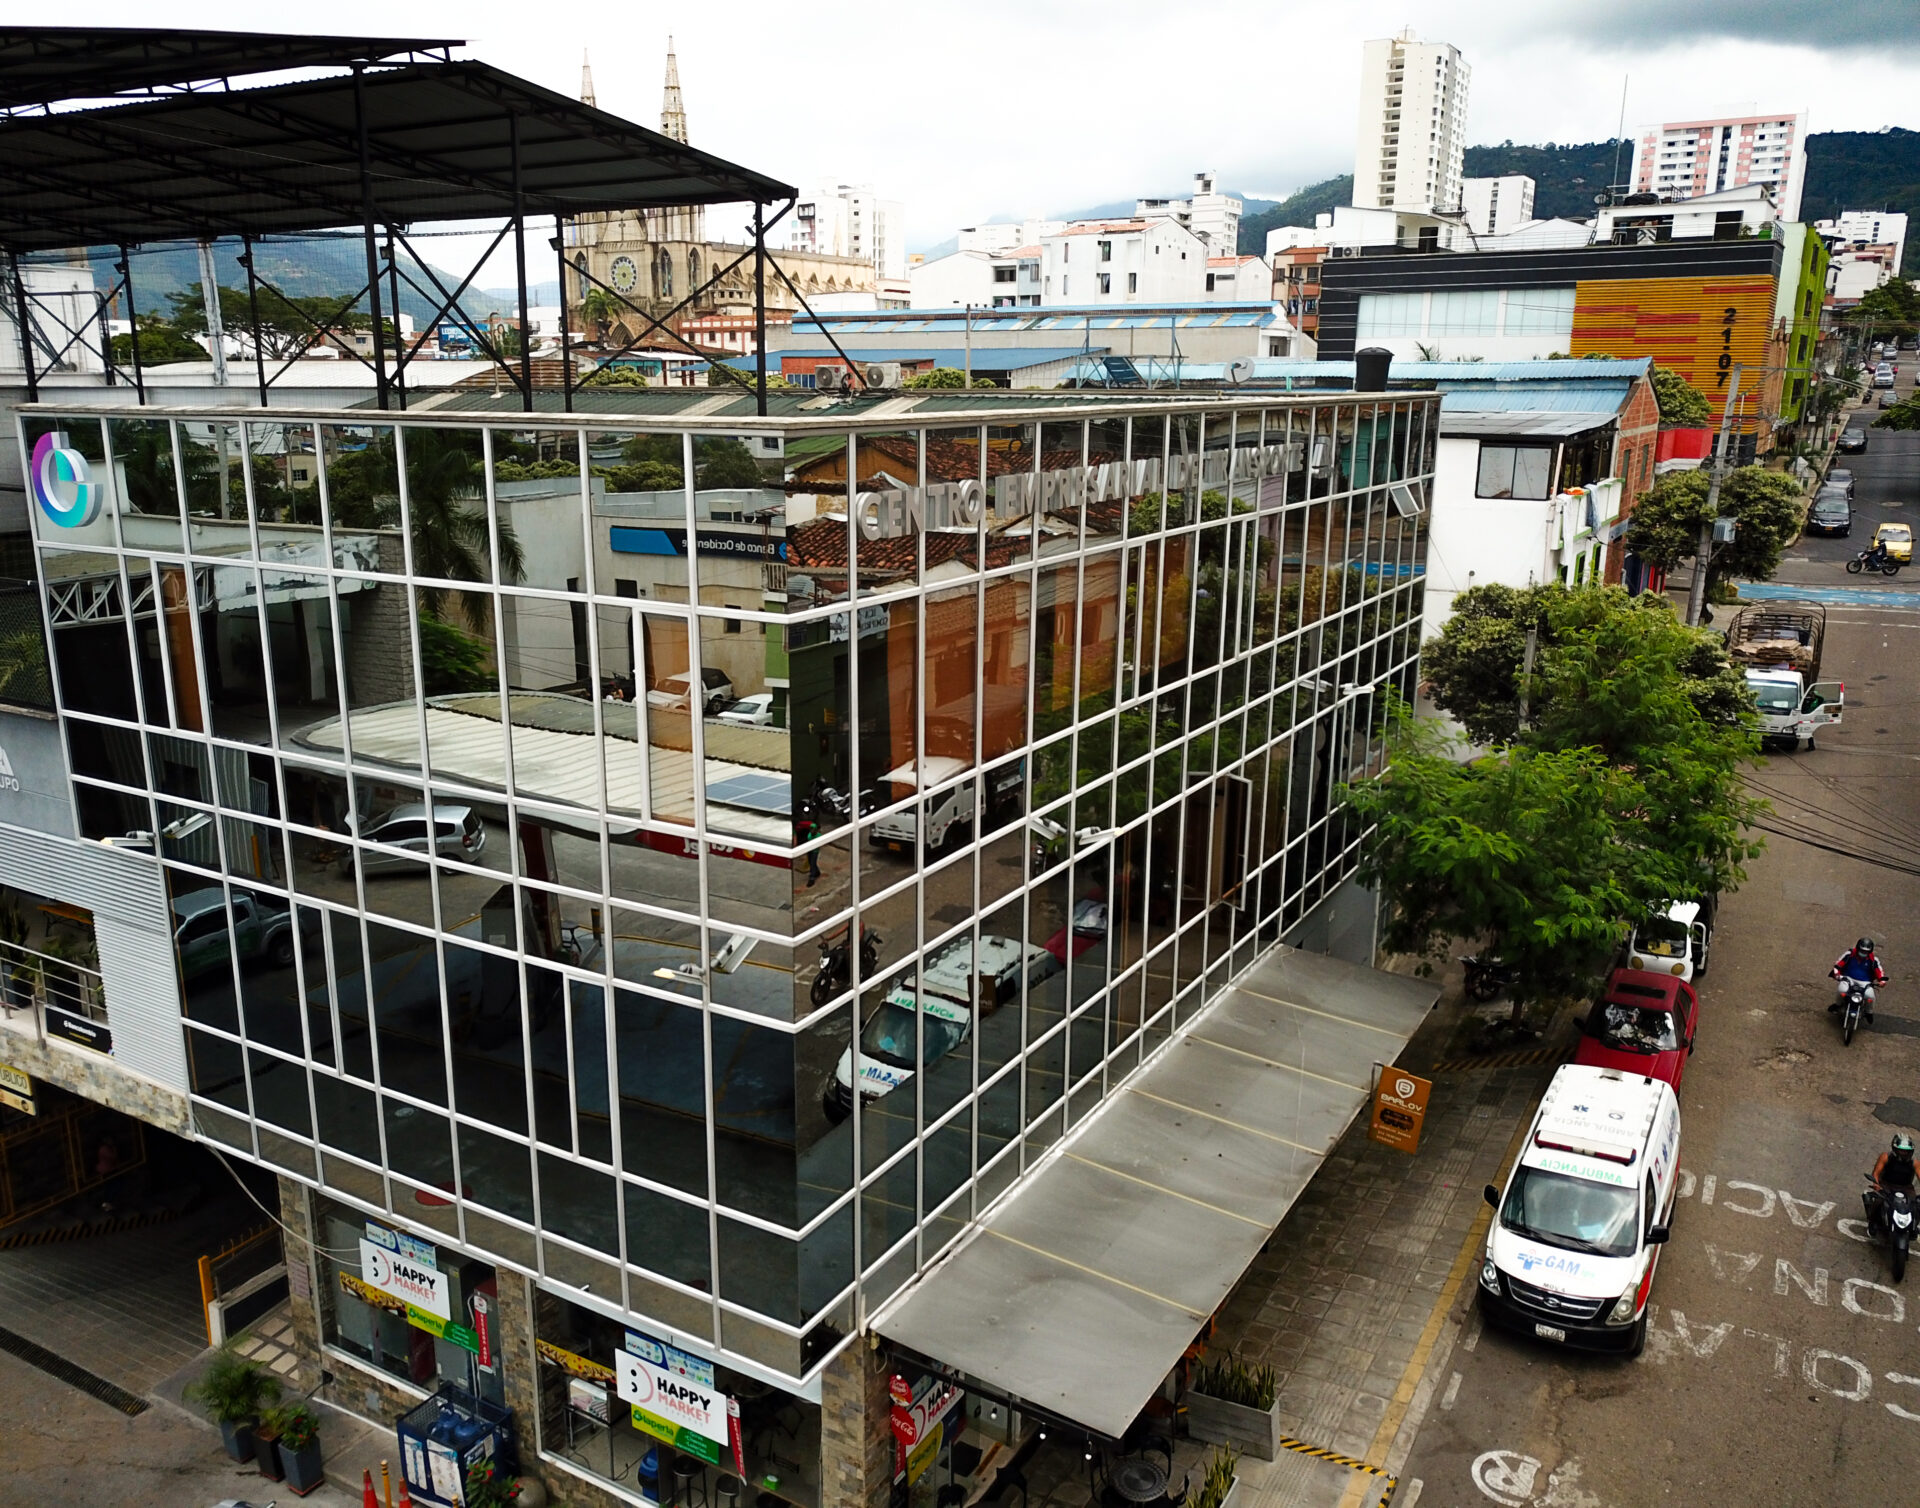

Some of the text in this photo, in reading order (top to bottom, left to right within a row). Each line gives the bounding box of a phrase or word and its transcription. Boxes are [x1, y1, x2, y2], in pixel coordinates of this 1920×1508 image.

[857, 479, 986, 541] CENTRO
[995, 457, 1165, 518] EMPRESARIAL
[1380, 1093, 1422, 1111] BARLOV
[393, 1261, 436, 1290] HAPPY
[1545, 1255, 1581, 1276] GAM
[393, 1275, 437, 1301] MARKET
[657, 1376, 711, 1411] HAPPY
[658, 1391, 711, 1424] MARKET
